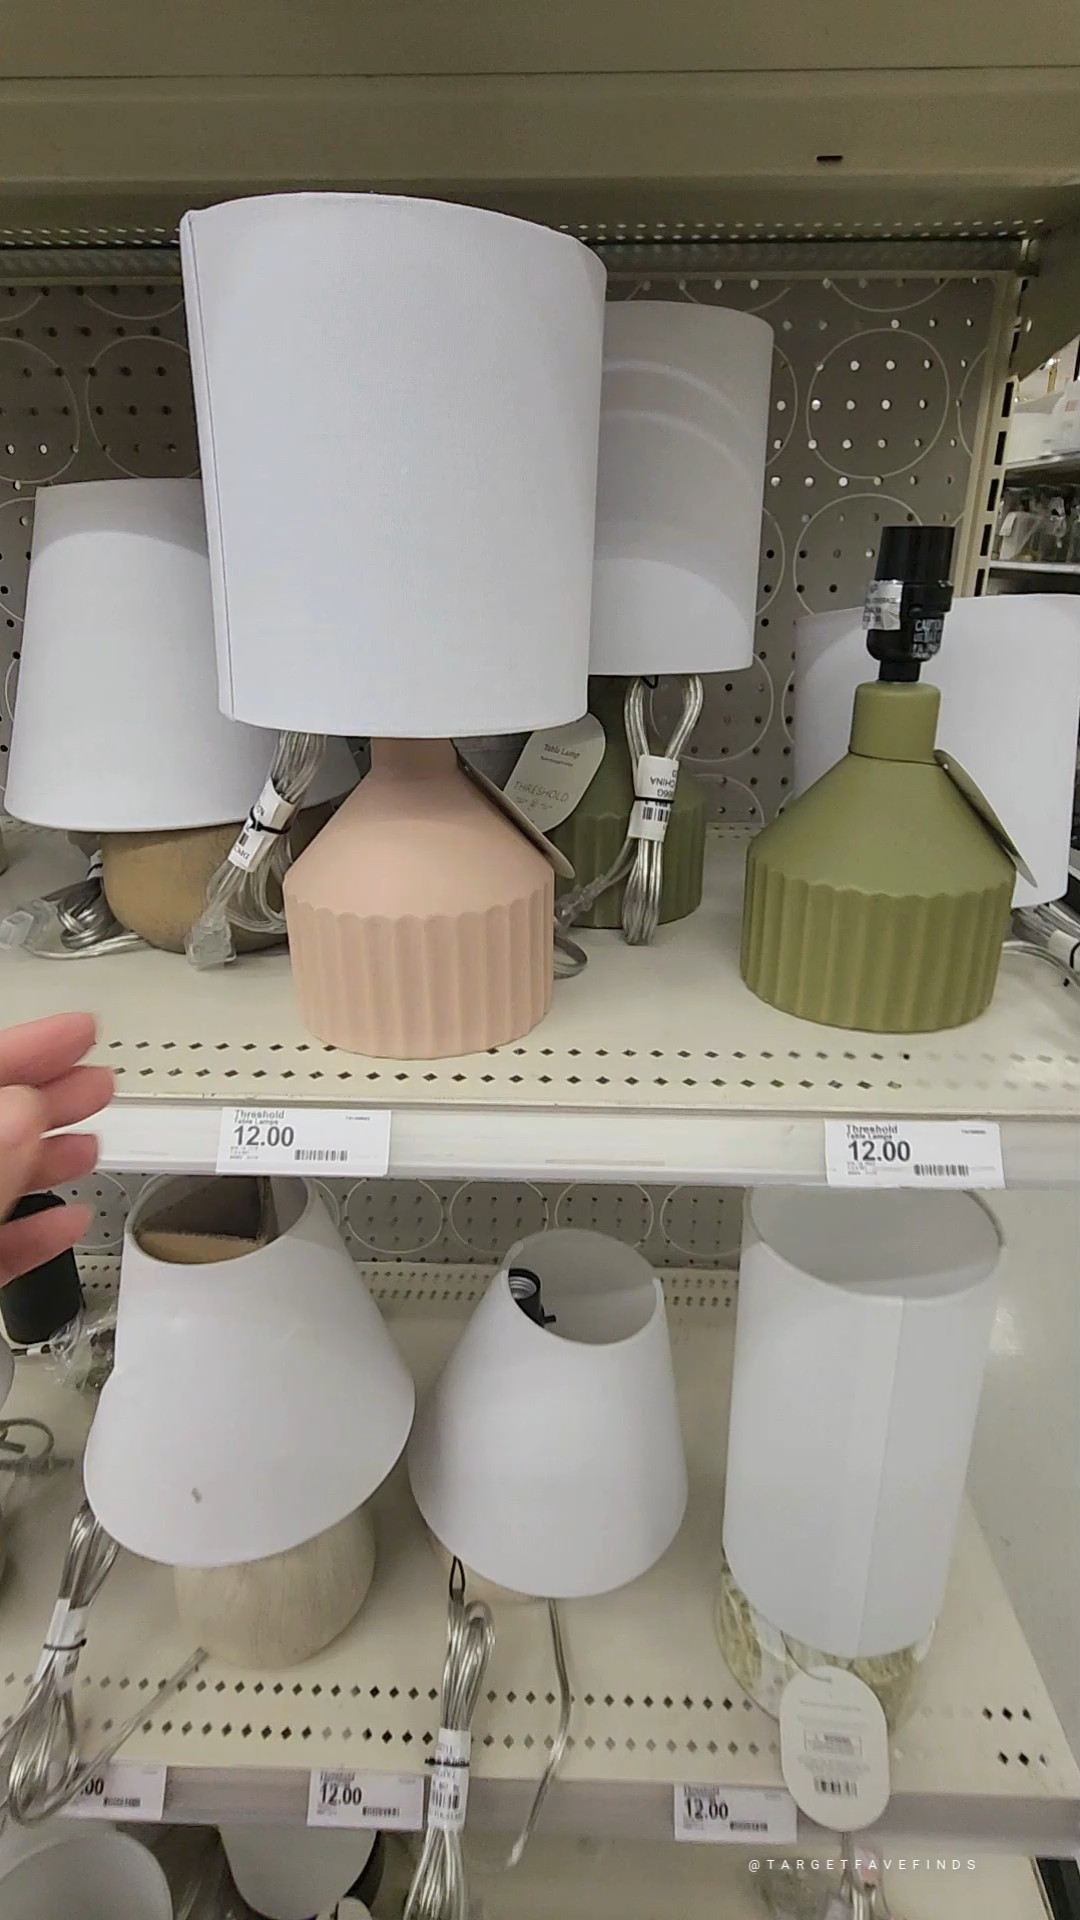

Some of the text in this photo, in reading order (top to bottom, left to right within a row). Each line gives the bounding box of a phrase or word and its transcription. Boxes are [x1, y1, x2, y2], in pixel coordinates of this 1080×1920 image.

[561, 747, 580, 759] Lamp
[513, 780, 570, 803] THRESHOLD
[650, 776, 675, 789] CHINA
[234, 1109, 285, 1120] Threshold
[233, 1125, 295, 1147] 12.00
[846, 1124, 898, 1135] Threshold
[847, 1140, 911, 1162] 12.00
[321, 1782, 363, 1806] 12.00
[685, 1797, 729, 1820] 12.00
